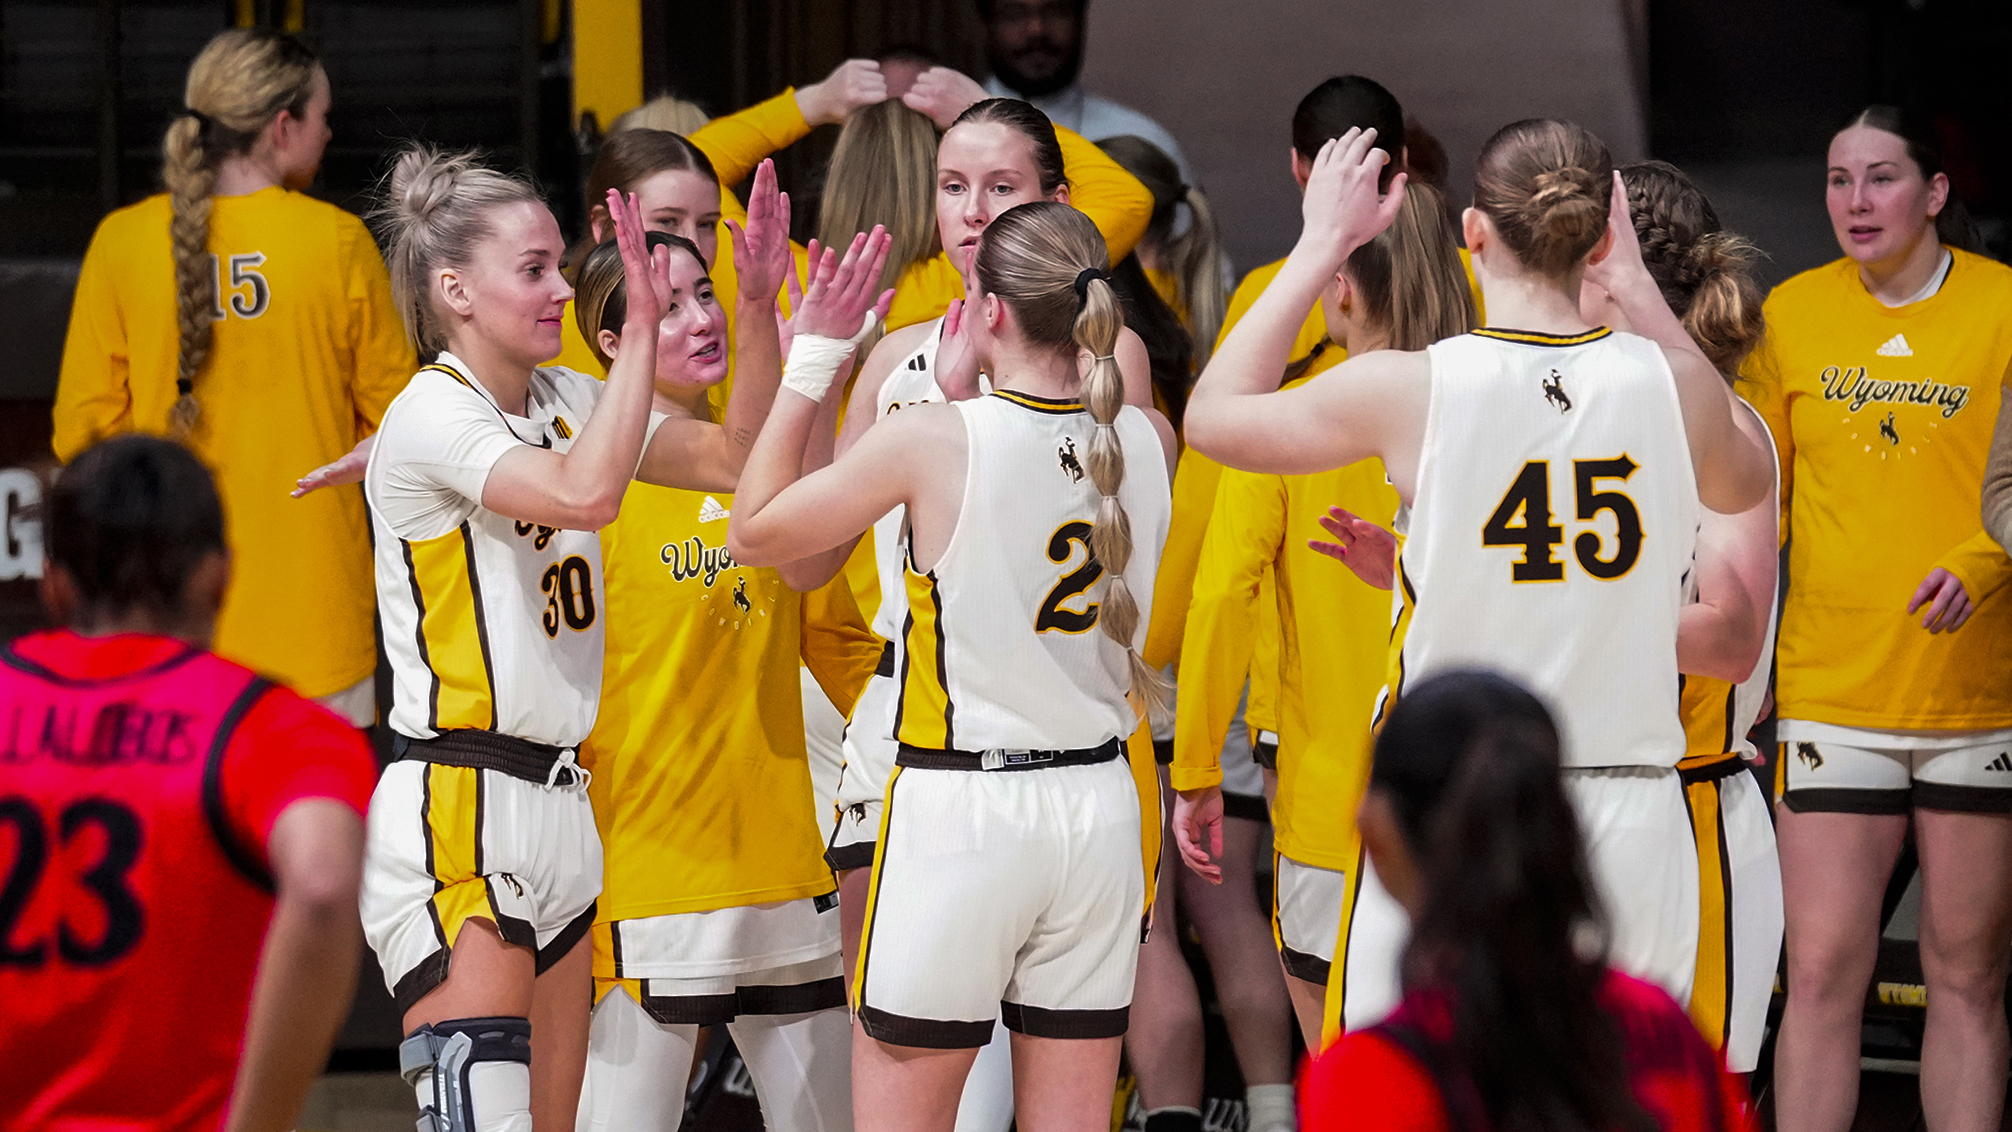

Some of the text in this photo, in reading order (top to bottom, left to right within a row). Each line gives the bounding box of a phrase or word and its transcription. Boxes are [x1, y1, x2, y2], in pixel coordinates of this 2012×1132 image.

[1820, 365, 1970, 419] Wyoming
[660, 536, 745, 588] Wyo
[1481, 451, 1647, 584] 45
[540, 554, 598, 640] 30
[1034, 519, 1105, 635] 2
[0, 796, 144, 970] 23
